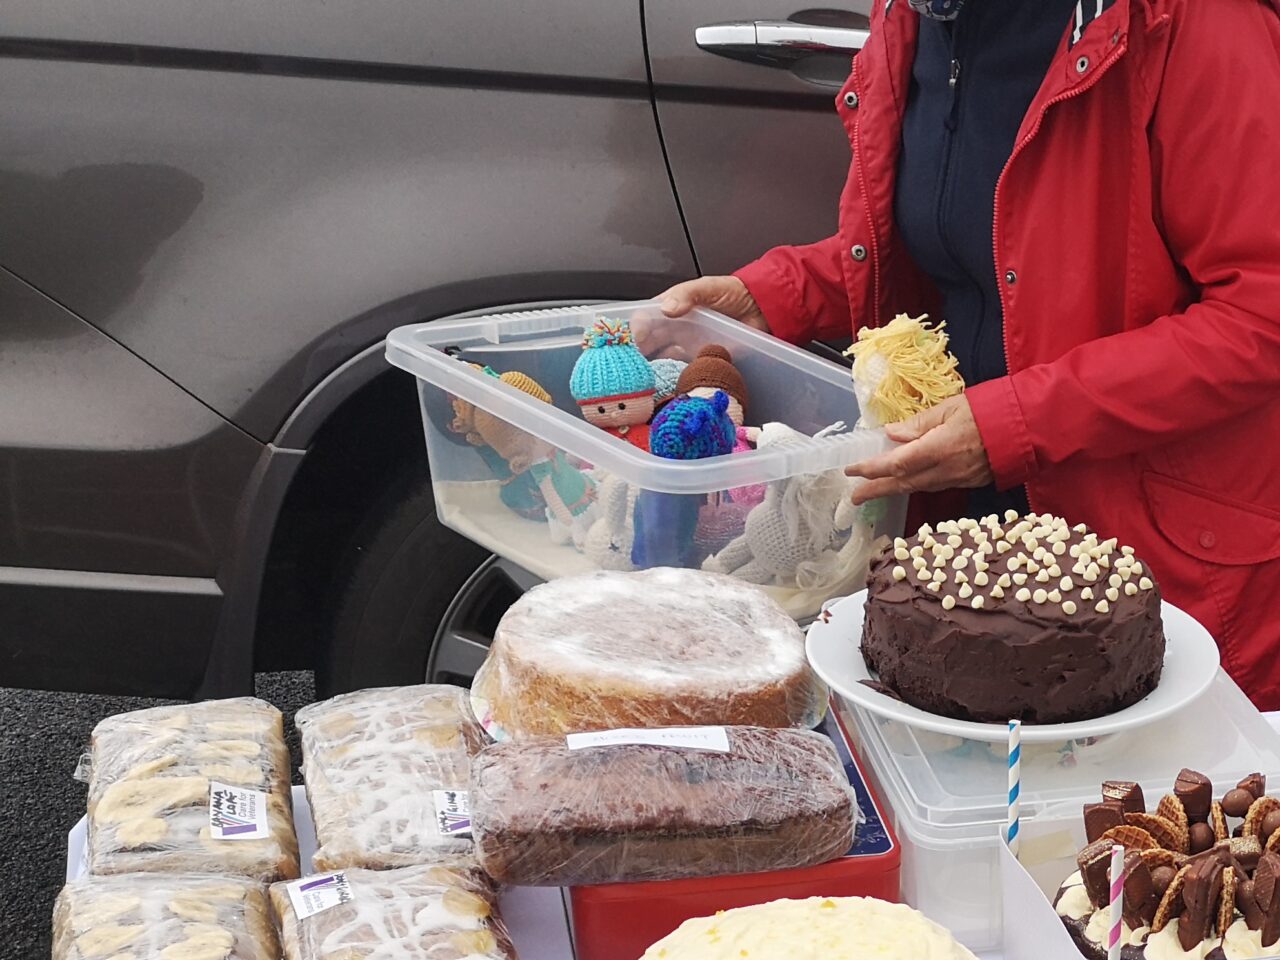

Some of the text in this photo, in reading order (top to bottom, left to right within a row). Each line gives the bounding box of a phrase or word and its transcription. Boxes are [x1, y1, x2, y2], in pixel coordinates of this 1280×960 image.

[238, 791, 247, 818] Care for
[247, 793, 256, 820] Veterans
